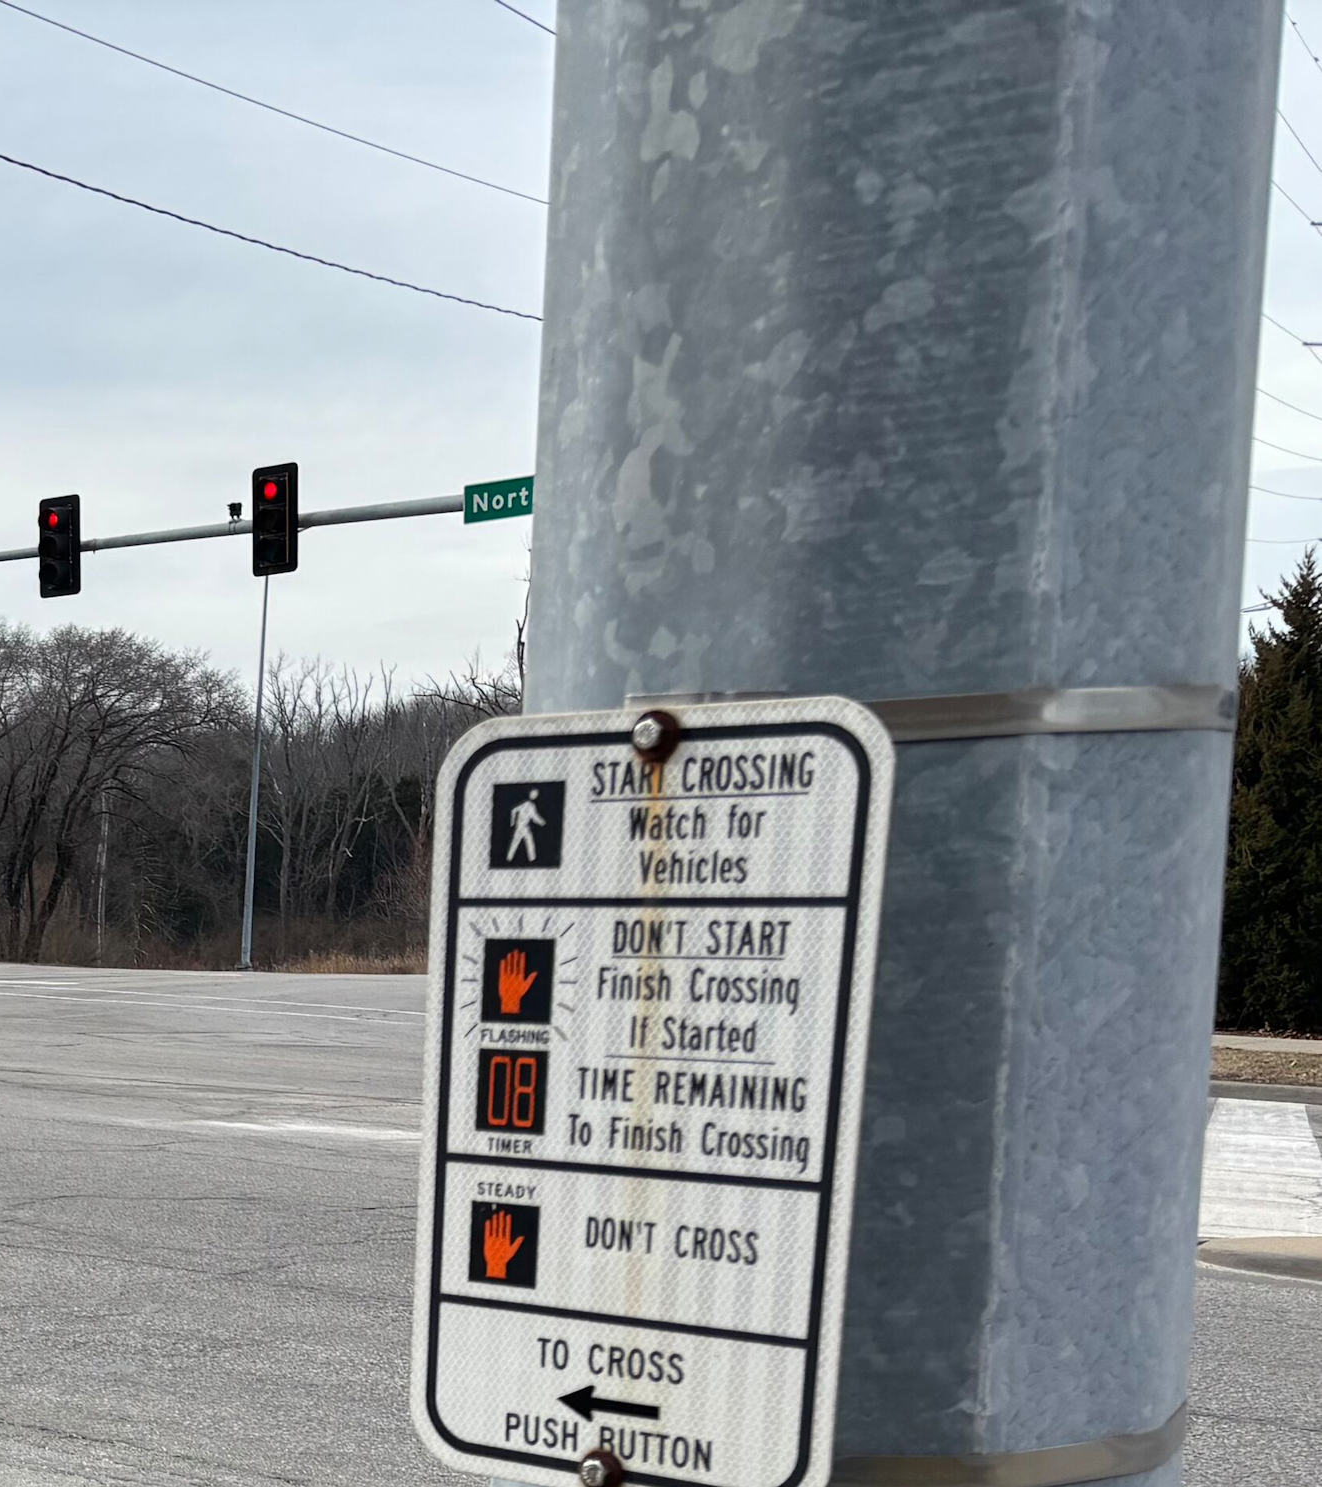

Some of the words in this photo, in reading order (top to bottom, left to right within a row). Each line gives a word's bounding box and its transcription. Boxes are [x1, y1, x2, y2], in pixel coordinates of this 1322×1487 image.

[472, 486, 529, 513] Nort
[592, 757, 664, 796] START
[682, 752, 815, 793] CROSSING
[630, 804, 706, 842] Watch
[728, 803, 768, 840] for
[640, 850, 748, 885] Vehicles
[612, 919, 687, 955] DON'T
[706, 920, 791, 957] START
[597, 967, 672, 1001] Finish
[689, 967, 801, 1014] Crossing
[480, 1028, 550, 1044] FLASHING
[629, 1015, 651, 1048] If
[661, 1020, 757, 1053] Started
[487, 1056, 537, 1128] 08
[577, 1067, 635, 1103] TIME
[656, 1074, 807, 1113] REMAINING
[488, 1137, 533, 1154] TIMER
[567, 1113, 593, 1148] To
[609, 1117, 683, 1154] Finish
[702, 1122, 811, 1175] Crossing
[476, 1181, 537, 1199] STEADY
[585, 1216, 656, 1256] DON'T
[674, 1225, 761, 1266] CROSS
[537, 1337, 569, 1371] TO
[588, 1344, 685, 1386] CROSS
[505, 1412, 579, 1452] PUSH
[600, 1426, 712, 1473] BUTTON
